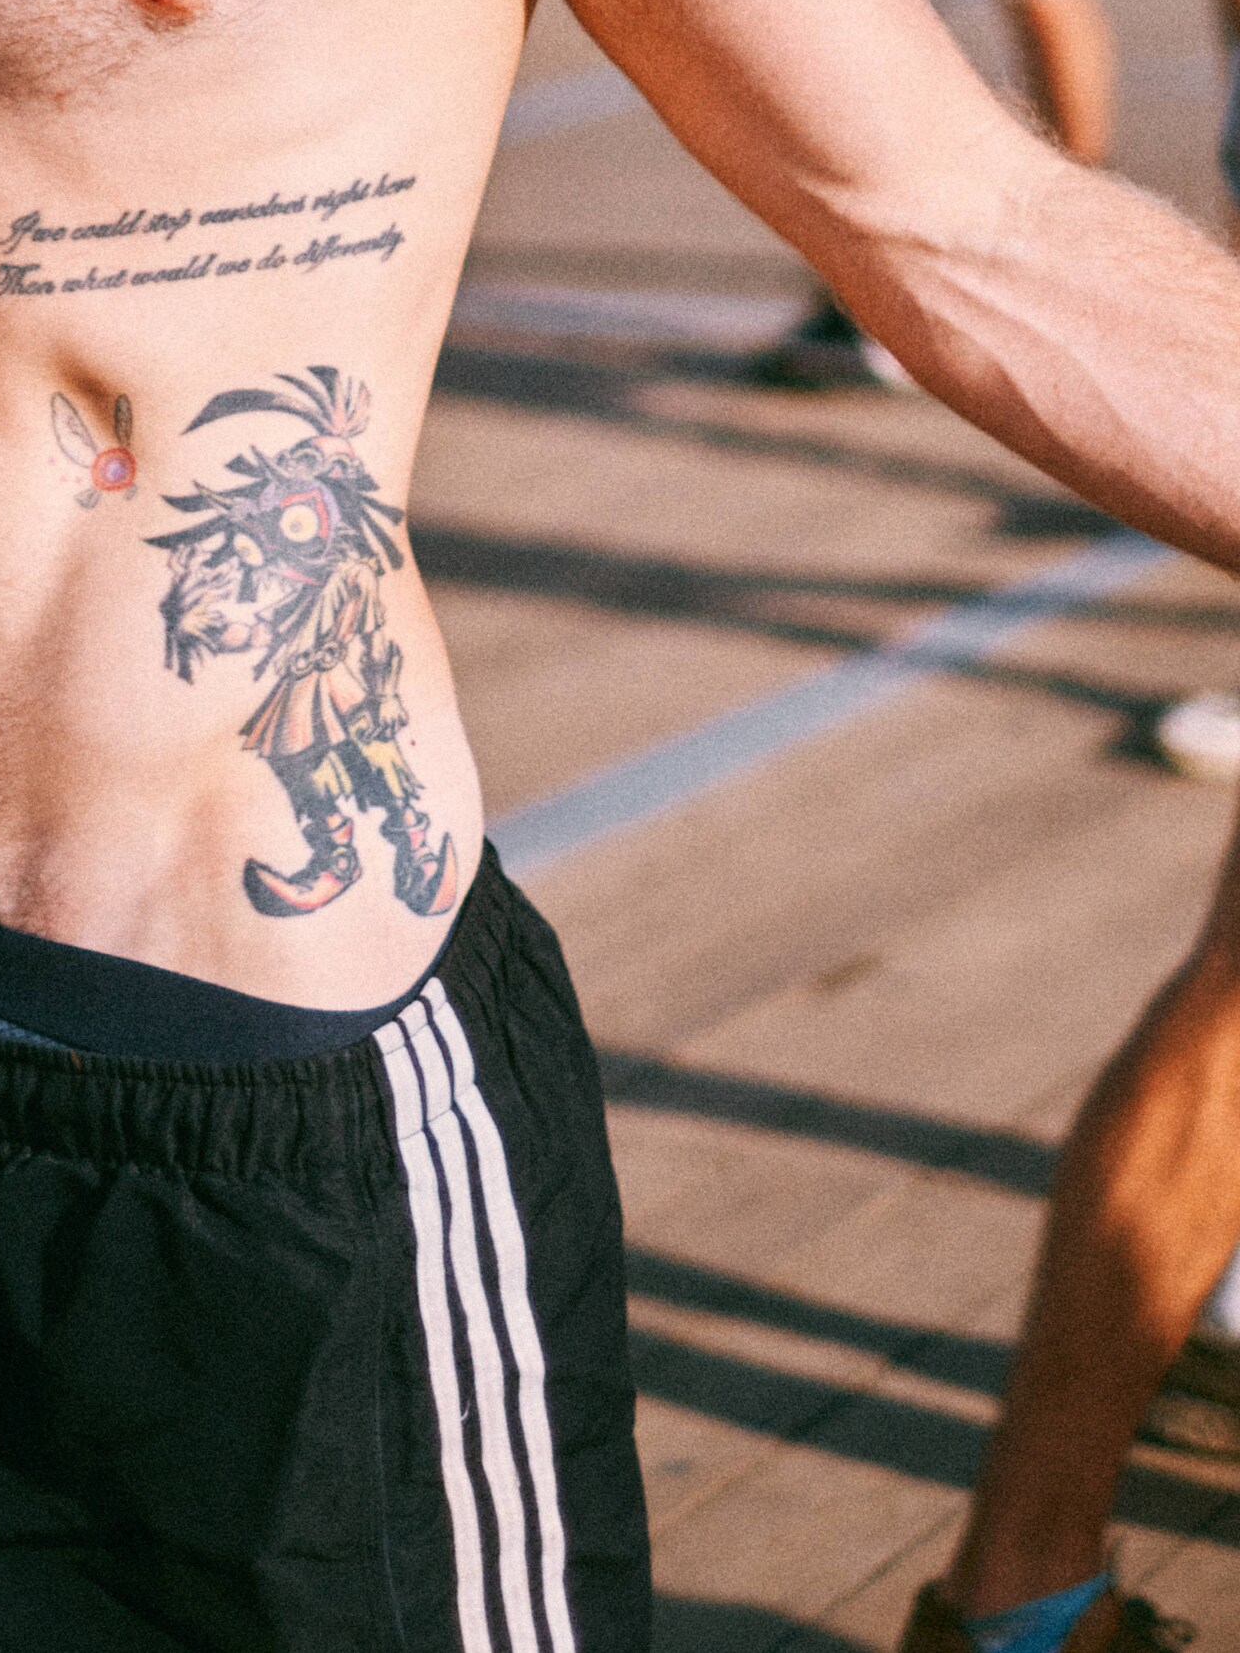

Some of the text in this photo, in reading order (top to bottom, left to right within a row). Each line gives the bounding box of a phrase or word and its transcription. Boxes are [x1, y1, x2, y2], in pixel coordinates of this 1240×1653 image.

[32, 226, 67, 243] we
[71, 208, 147, 241] could
[142, 208, 192, 242] stop
[198, 192, 307, 227] ourselves
[311, 178, 372, 222] right
[371, 172, 417, 197] here
[61, 266, 129, 293] what
[130, 252, 218, 286] would
[215, 258, 252, 277] we
[256, 244, 287, 270] do
